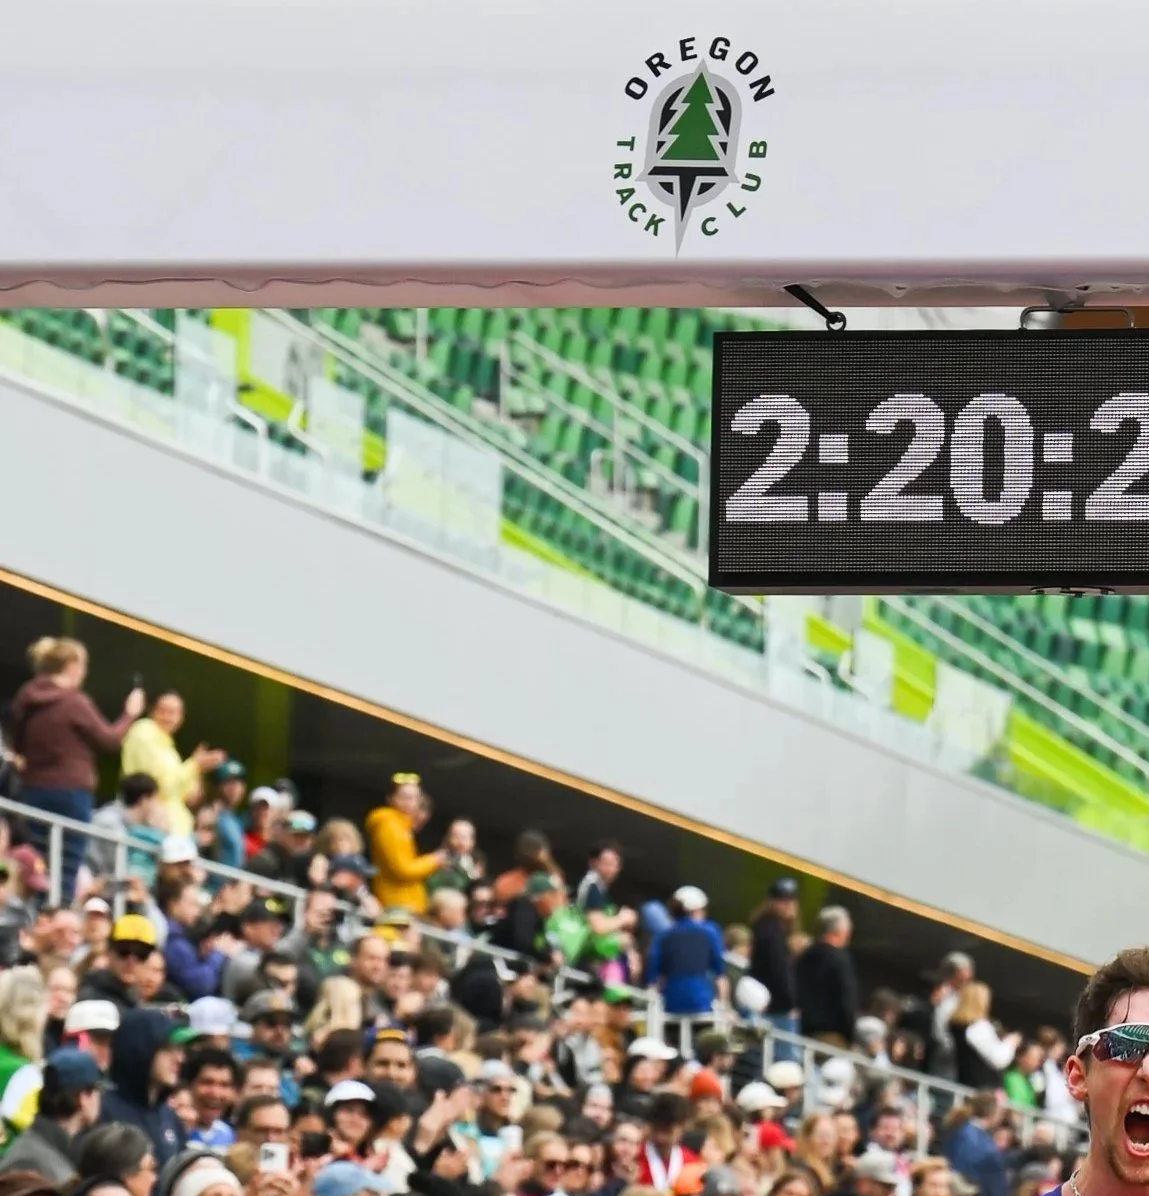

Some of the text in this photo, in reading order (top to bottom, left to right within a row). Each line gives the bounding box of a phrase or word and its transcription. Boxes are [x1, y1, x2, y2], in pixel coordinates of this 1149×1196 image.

[624, 36, 776, 103] OREGON
[613, 136, 768, 237] TRACK CLUB
